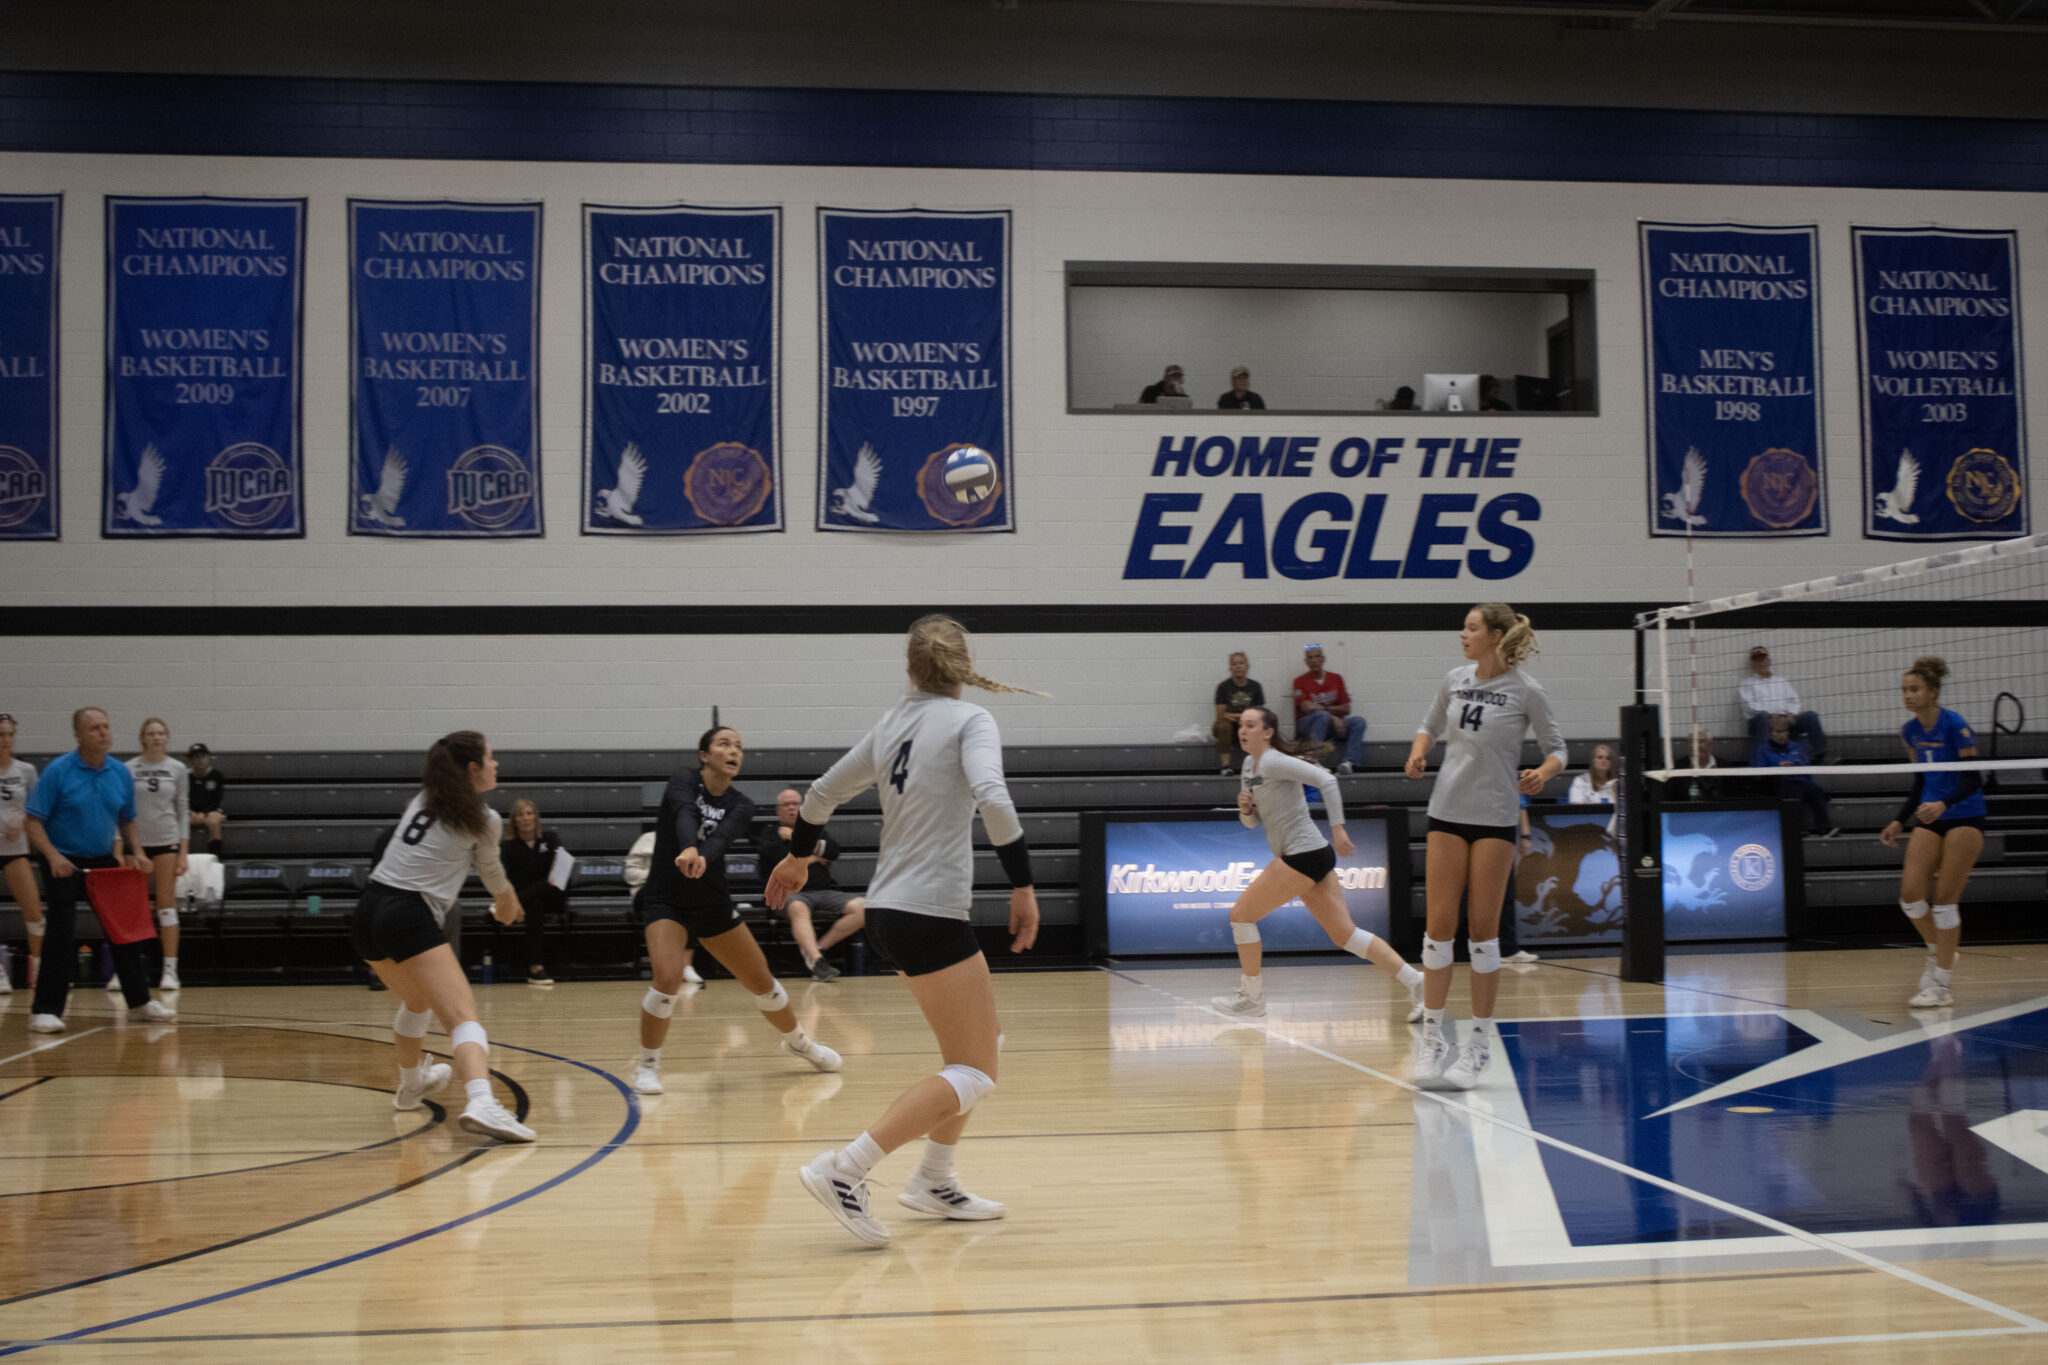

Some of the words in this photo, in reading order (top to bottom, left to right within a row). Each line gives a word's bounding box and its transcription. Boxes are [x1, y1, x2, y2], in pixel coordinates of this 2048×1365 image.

[137, 227, 274, 249] NATIONAL
[378, 231, 513, 254] NATIONAL
[613, 236, 751, 258] NATIONAL
[848, 240, 983, 262] NATIONAL
[122, 255, 287, 276] CHAMPIONS
[363, 258, 525, 281] CHAMPIONS
[600, 263, 766, 285] CHAMPIONS
[1669, 253, 1794, 274] NATIONAL
[833, 266, 996, 289] CHAMPIONS
[1878, 270, 1998, 291] NATIONAL
[1658, 278, 1808, 300] CHAMPIONS
[1868, 296, 2010, 317] CHAMPIONS
[140, 329, 270, 350] WOMEN'S
[381, 332, 507, 354] WOMEN'S
[618, 338, 748, 360] WOMEN'S
[851, 342, 980, 363] WOMEN'S
[1699, 349, 1775, 371] MEN'S
[1886, 350, 1999, 371] WOMEN'S
[120, 356, 287, 378] BASKETBALL
[363, 358, 526, 381] BASKETBALL
[599, 364, 767, 387] BASKETBALL
[832, 368, 997, 390] BASKETBALL
[1660, 374, 1812, 396] BASKETBALL
[1871, 375, 2013, 397] VOLLEYBALL
[175, 383, 235, 405] 2009
[416, 387, 471, 408] 2007
[656, 393, 711, 414] 2002
[891, 396, 939, 417] 1997
[1714, 400, 1761, 422] 1998
[1920, 403, 1967, 423] 2003
[1151, 435, 1320, 477] HOME
[1329, 437, 1404, 478] OF
[1415, 437, 1521, 478] THE
[1122, 491, 1541, 580] EAGLES
[1459, 703, 1484, 732] 14
[890, 739, 913, 795] 4
[147, 777, 159, 793] 9
[402, 809, 436, 846] 8
